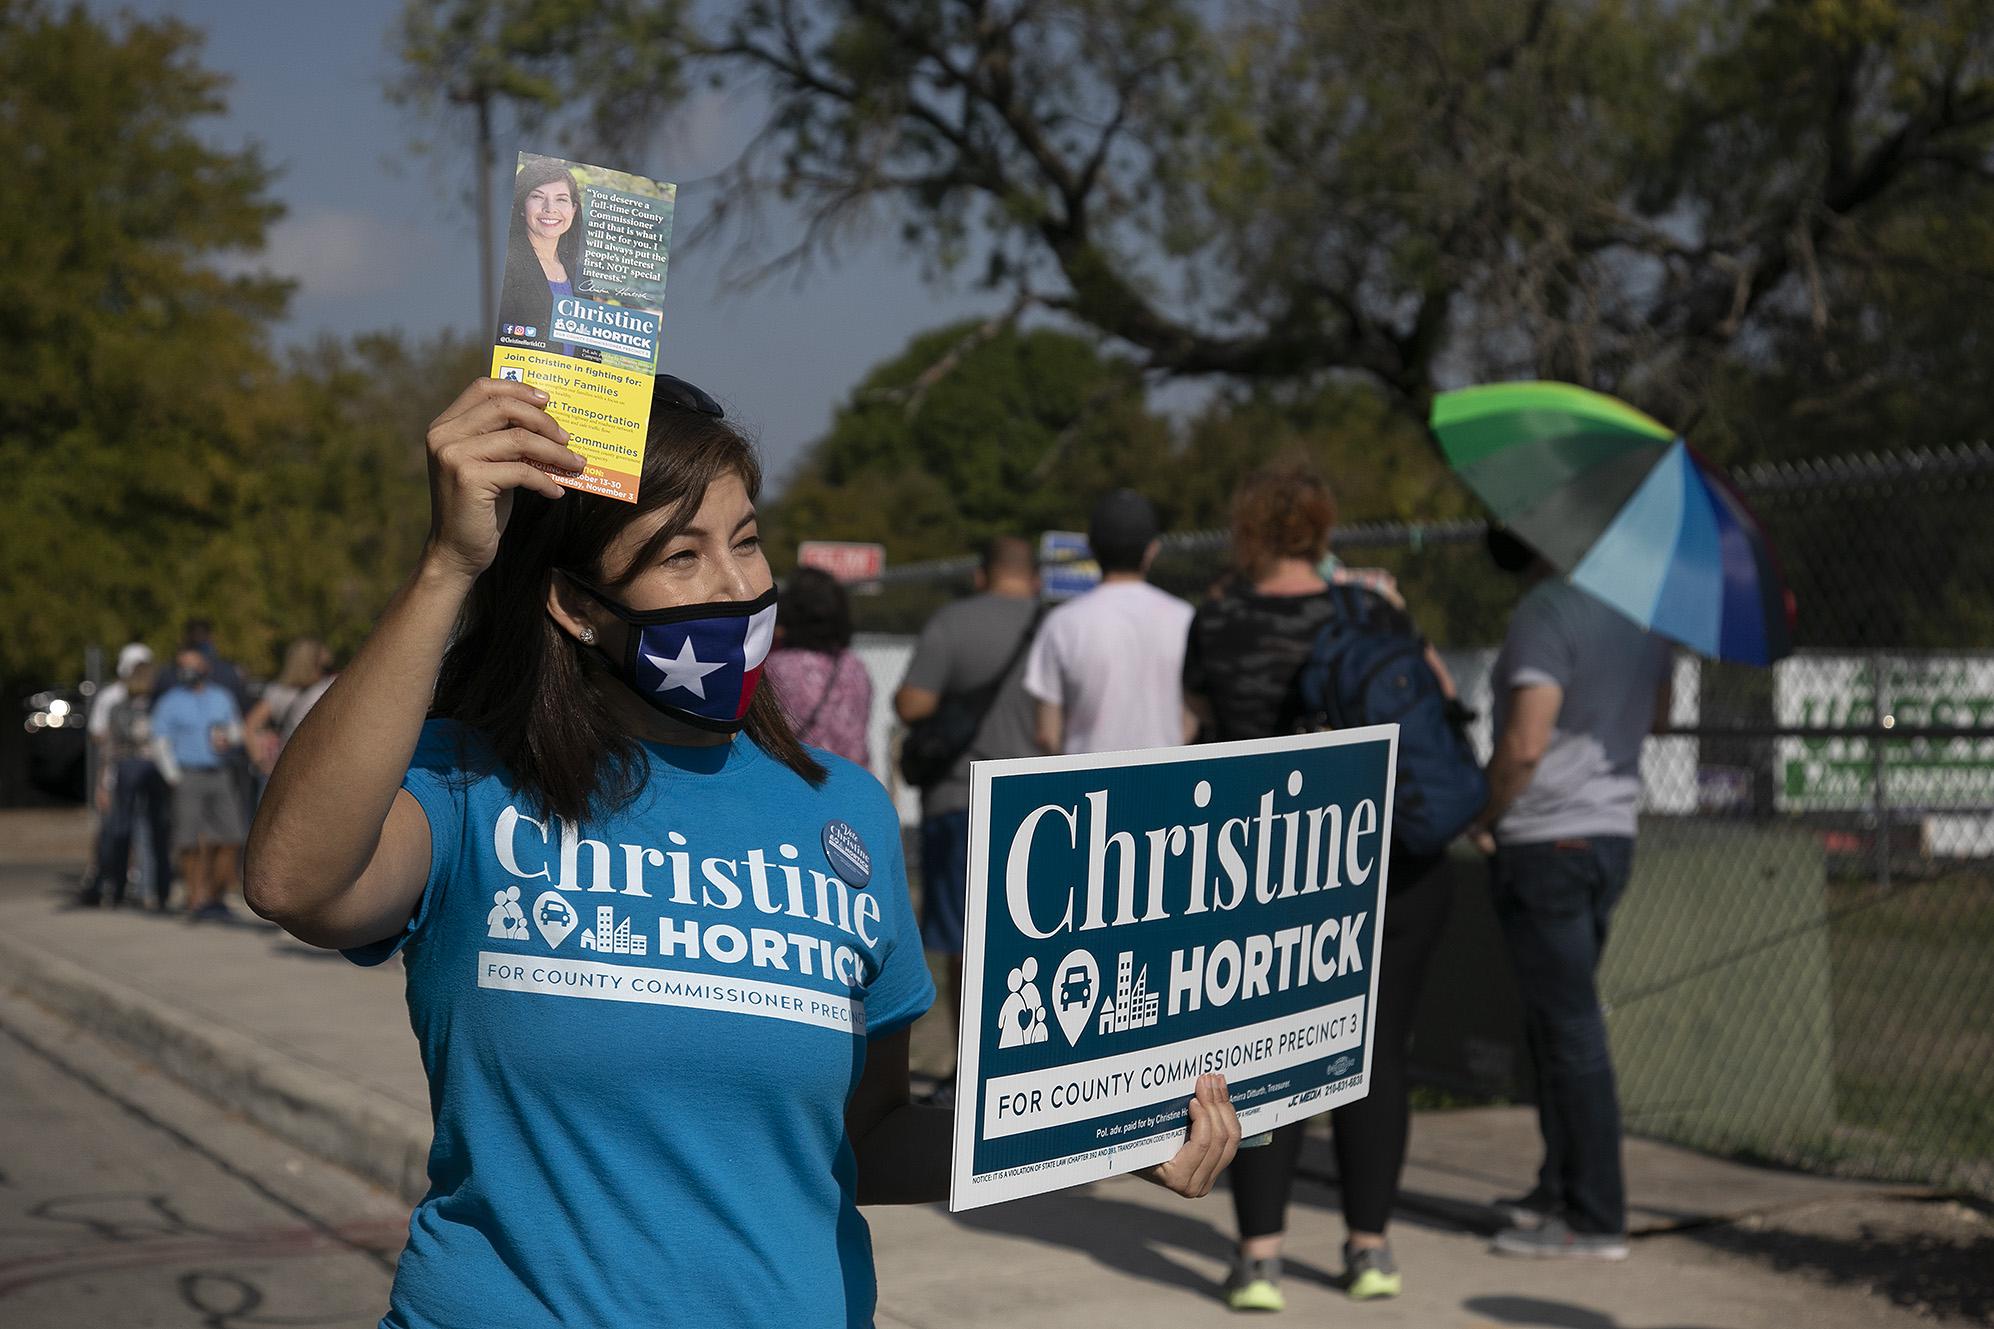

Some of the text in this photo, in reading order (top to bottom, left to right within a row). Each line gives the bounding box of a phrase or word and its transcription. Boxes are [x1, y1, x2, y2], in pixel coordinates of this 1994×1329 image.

[591, 200, 663, 224] full-time County
[610, 194, 643, 207] deserve
[588, 220, 605, 229] and
[607, 224, 624, 233] that
[636, 230, 656, 240] what
[590, 210, 654, 229] Commissioner
[586, 240, 666, 263] will always put the
[606, 232, 616, 241] be
[618, 235, 632, 244] for
[633, 240, 652, 249] you.
[584, 259, 661, 281] first, NOT special
[622, 256, 655, 270] interest
[557, 300, 654, 334] Christine
[592, 327, 651, 348] HORTICK
[504, 354, 525, 362] Join
[528, 356, 571, 371] Christine
[585, 367, 623, 383] fighting
[625, 376, 642, 387] for:
[527, 370, 570, 386] Healthy
[574, 379, 619, 397] Families
[562, 402, 640, 429] Transportation
[569, 433, 638, 457] Communities
[551, 474, 585, 488] Tuesday,
[586, 482, 626, 498] November
[566, 470, 598, 483] October
[600, 477, 621, 489] 13-30
[830, 826, 870, 863] Christine
[1006, 770, 1377, 939] Christine
[494, 805, 880, 950] Christine
[1168, 912, 1368, 1017] HORTICK
[488, 964, 524, 982] FOR
[532, 968, 623, 990] COUNTY
[632, 978, 803, 1012] COMMISSIONER
[998, 1014, 1358, 1119] FOR COUNTY COMMISSIONER PRECINCT 3
[1300, 1089, 1322, 1104] MEDIA
[1096, 1128, 1108, 1138] Pol.
[1110, 1126, 1122, 1136] adv.
[1124, 1122, 1137, 1134] paid
[1138, 1120, 1147, 1128] for
[1147, 1117, 1155, 1127] by
[1156, 1110, 1180, 1124] Christine
[972, 1176, 992, 1184] NOTICE:
[1008, 1165, 1034, 1177] VIOLATION
[1035, 1164, 1041, 1172] OF
[1042, 1161, 1056, 1170] STATE
[1056, 1159, 1066, 1167] LAW
[1097, 1149, 1108, 1158] AND
[1118, 1138, 1153, 1152] TRANSPORTATION
